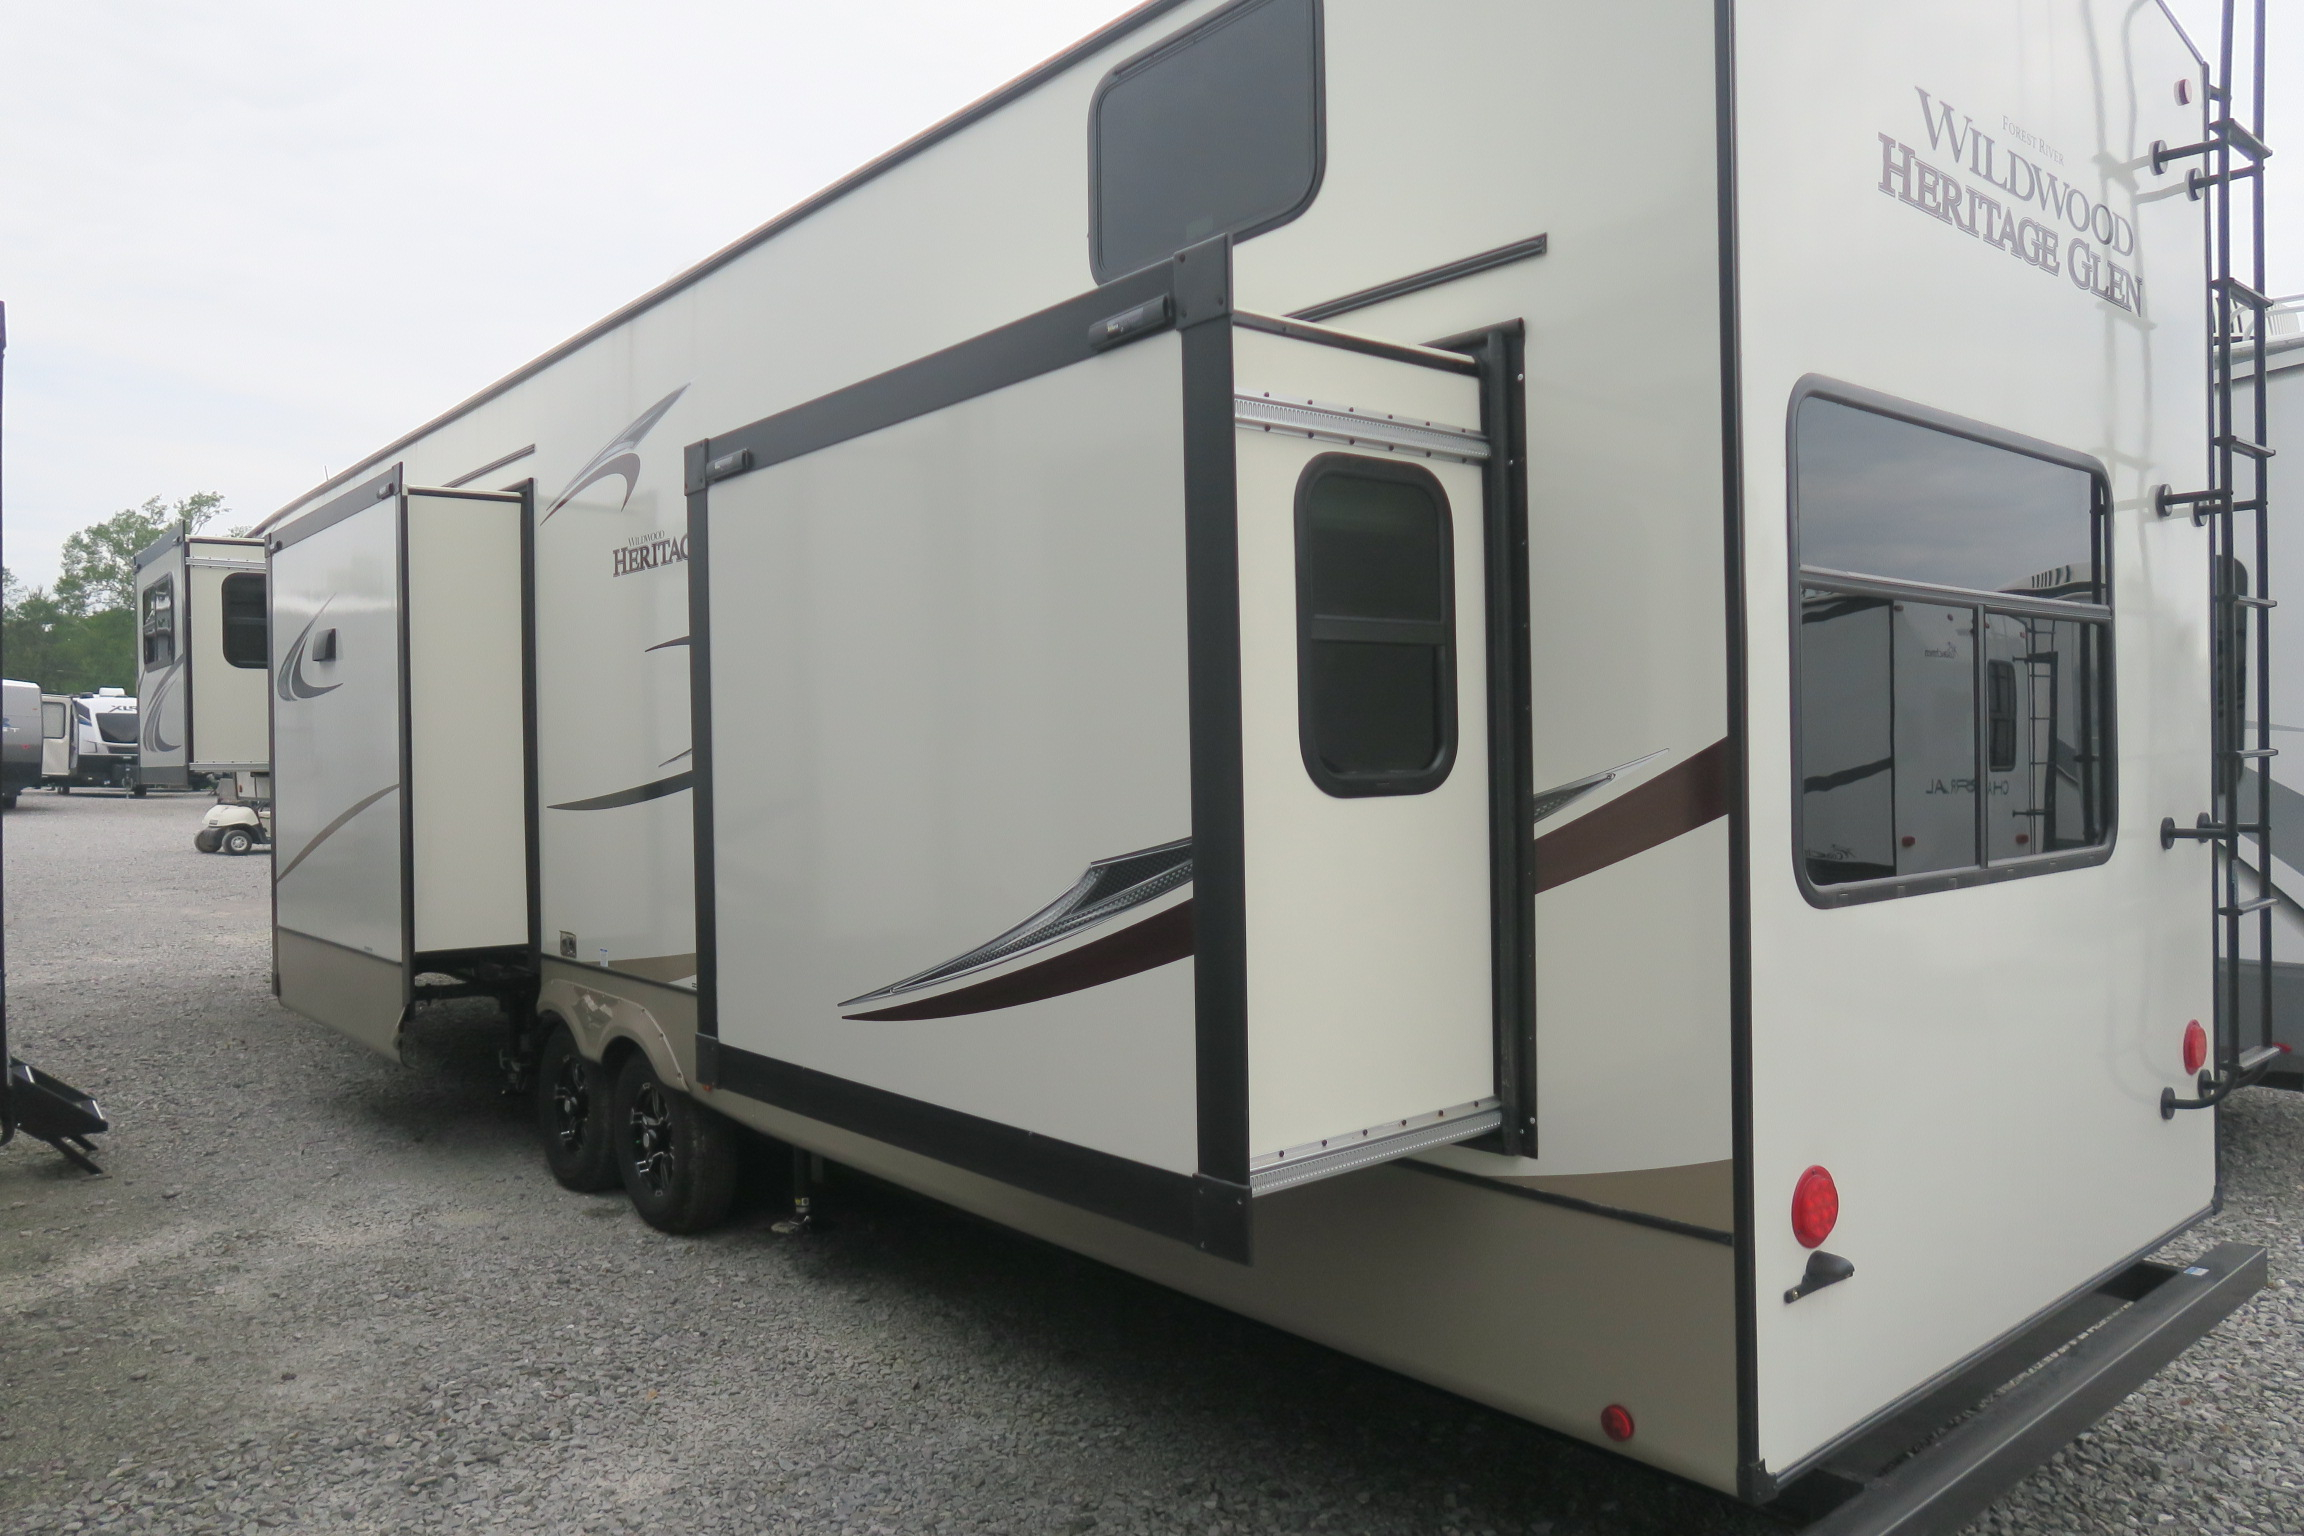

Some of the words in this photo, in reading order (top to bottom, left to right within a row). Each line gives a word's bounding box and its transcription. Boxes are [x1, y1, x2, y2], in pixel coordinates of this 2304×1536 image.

[1914, 85, 2134, 257] WILDWOOD
[2002, 114, 2037, 149] FOREST
[2039, 138, 2065, 166] RIVER
[1877, 131, 2060, 277] HERITAGE
[2067, 237, 2143, 318] GLEN
[628, 529, 665, 547] WILDWOOD
